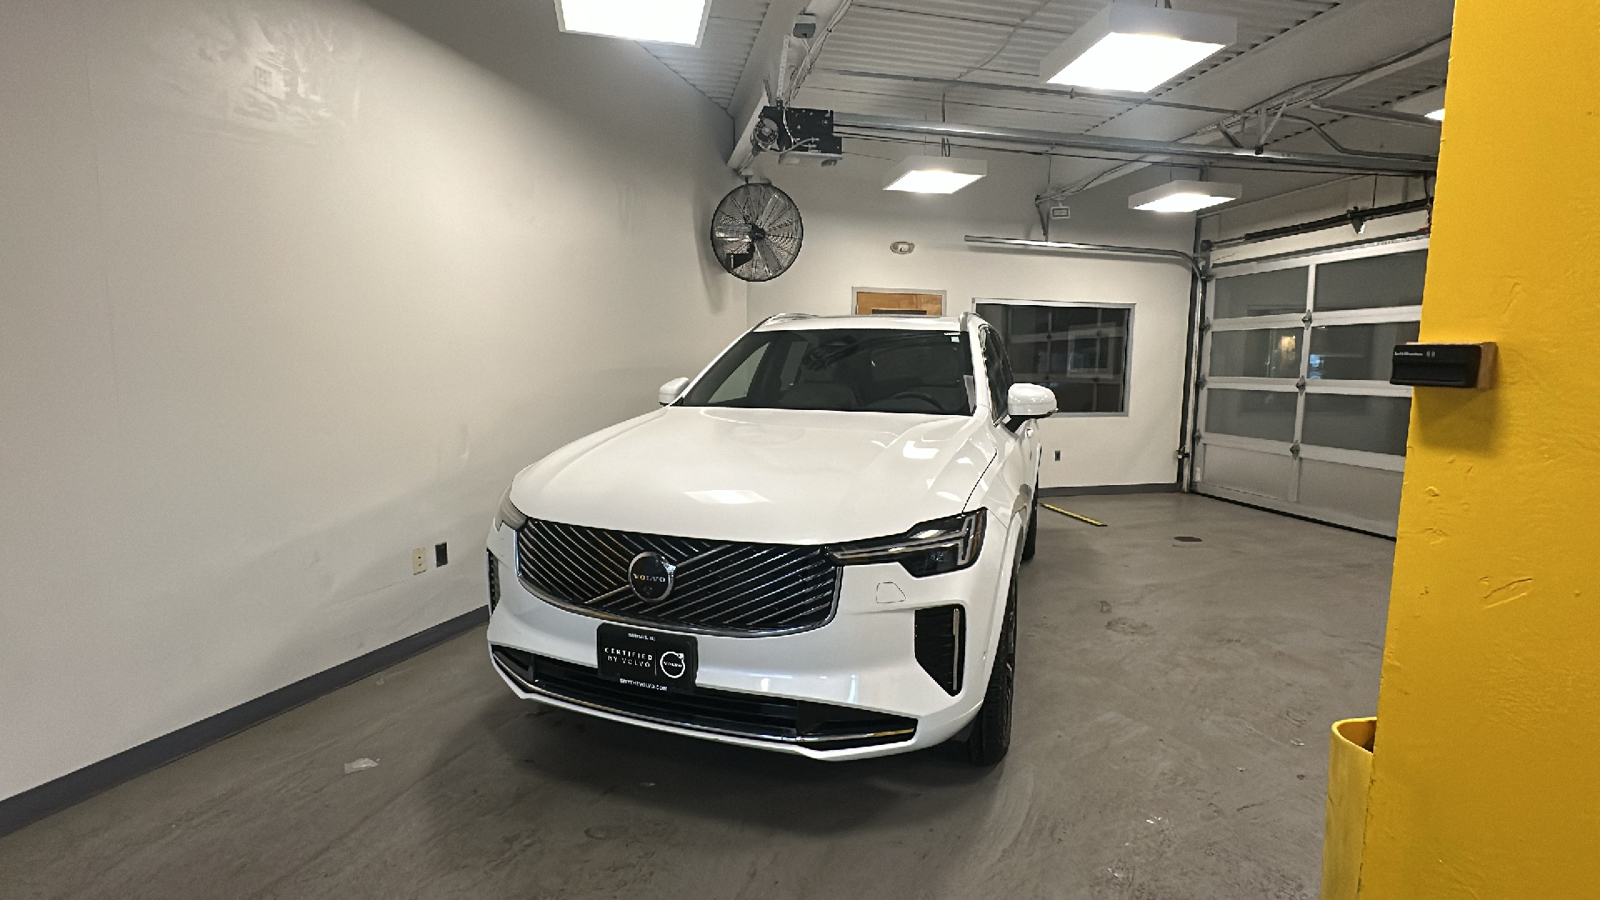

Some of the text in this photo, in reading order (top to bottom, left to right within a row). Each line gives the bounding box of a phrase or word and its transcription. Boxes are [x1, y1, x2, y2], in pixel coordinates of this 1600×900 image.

[633, 573, 666, 582] VOLVO
[604, 647, 653, 660] CERTIFIED
[622, 658, 651, 667] VOLVO
